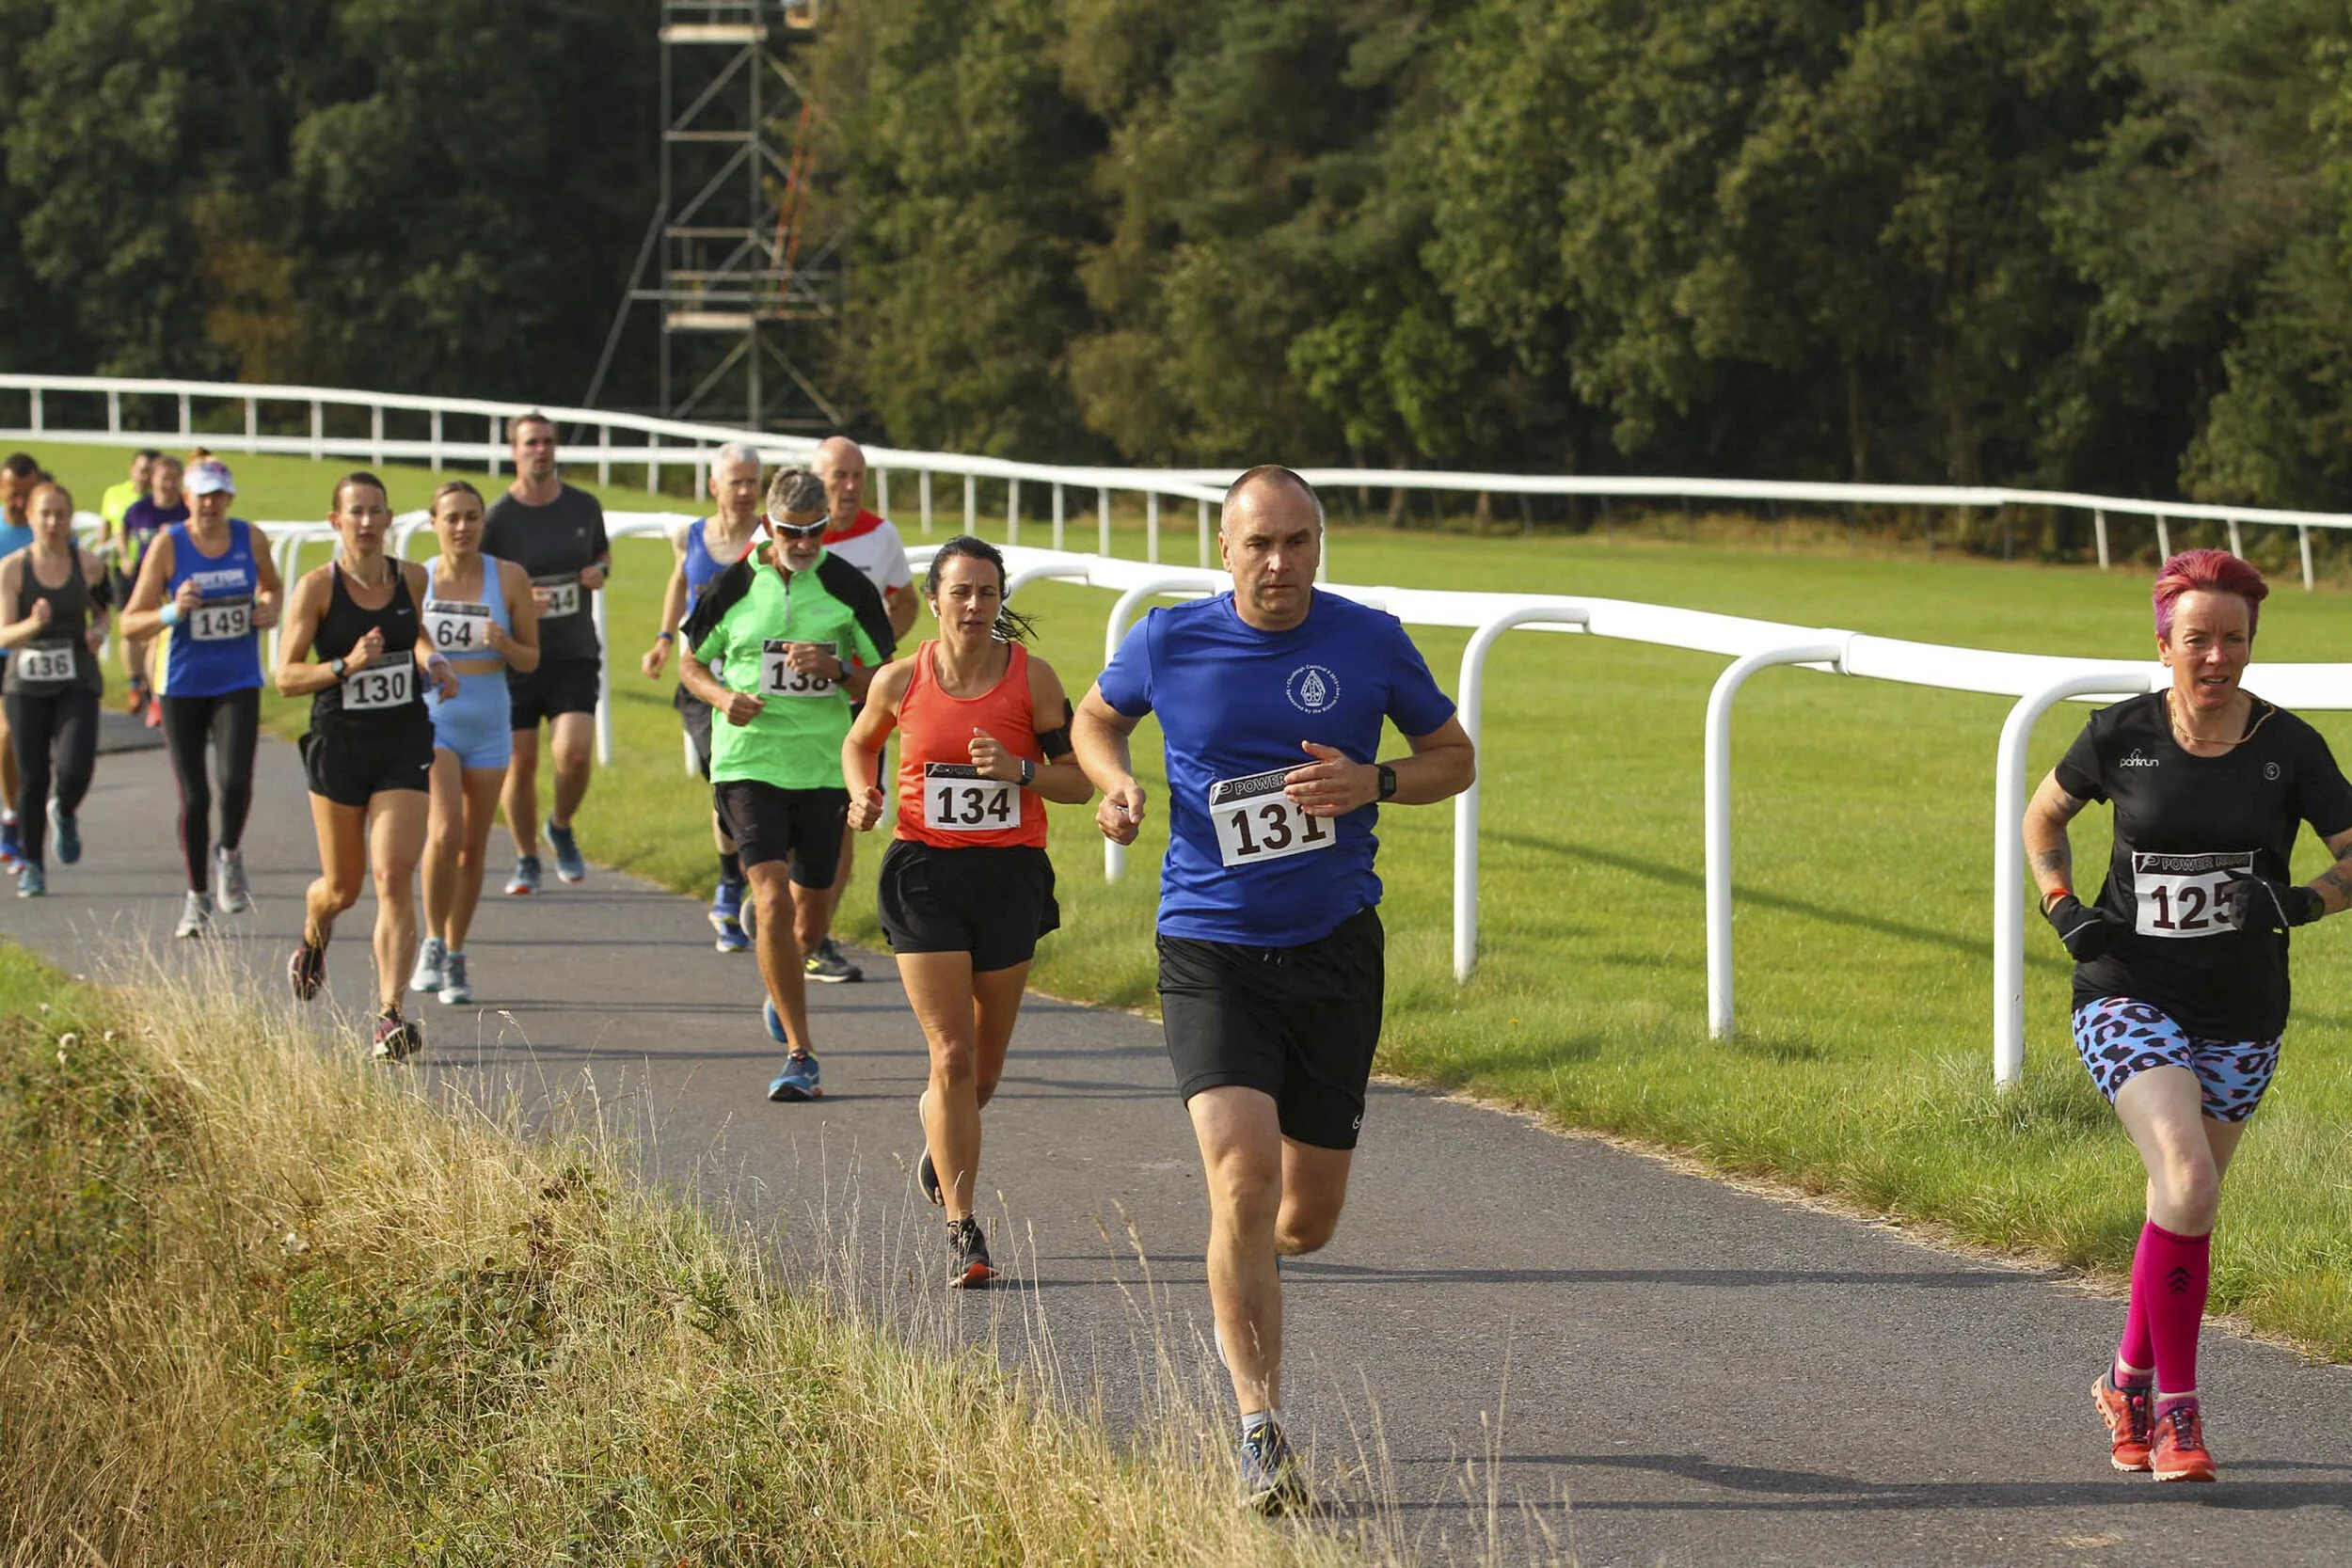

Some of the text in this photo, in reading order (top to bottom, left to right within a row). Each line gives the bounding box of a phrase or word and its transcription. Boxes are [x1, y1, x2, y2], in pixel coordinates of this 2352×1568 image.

[201, 610, 245, 635] 149
[437, 620, 472, 646] 64
[28, 654, 69, 676] 136
[354, 673, 405, 704] 130
[2120, 751, 2159, 768] parkrun
[1234, 773, 1286, 795] POWER
[938, 786, 1010, 824] 134
[1232, 803, 1327, 856] 131
[2161, 856, 2214, 871] POWER
[2152, 881, 2233, 930] 125
